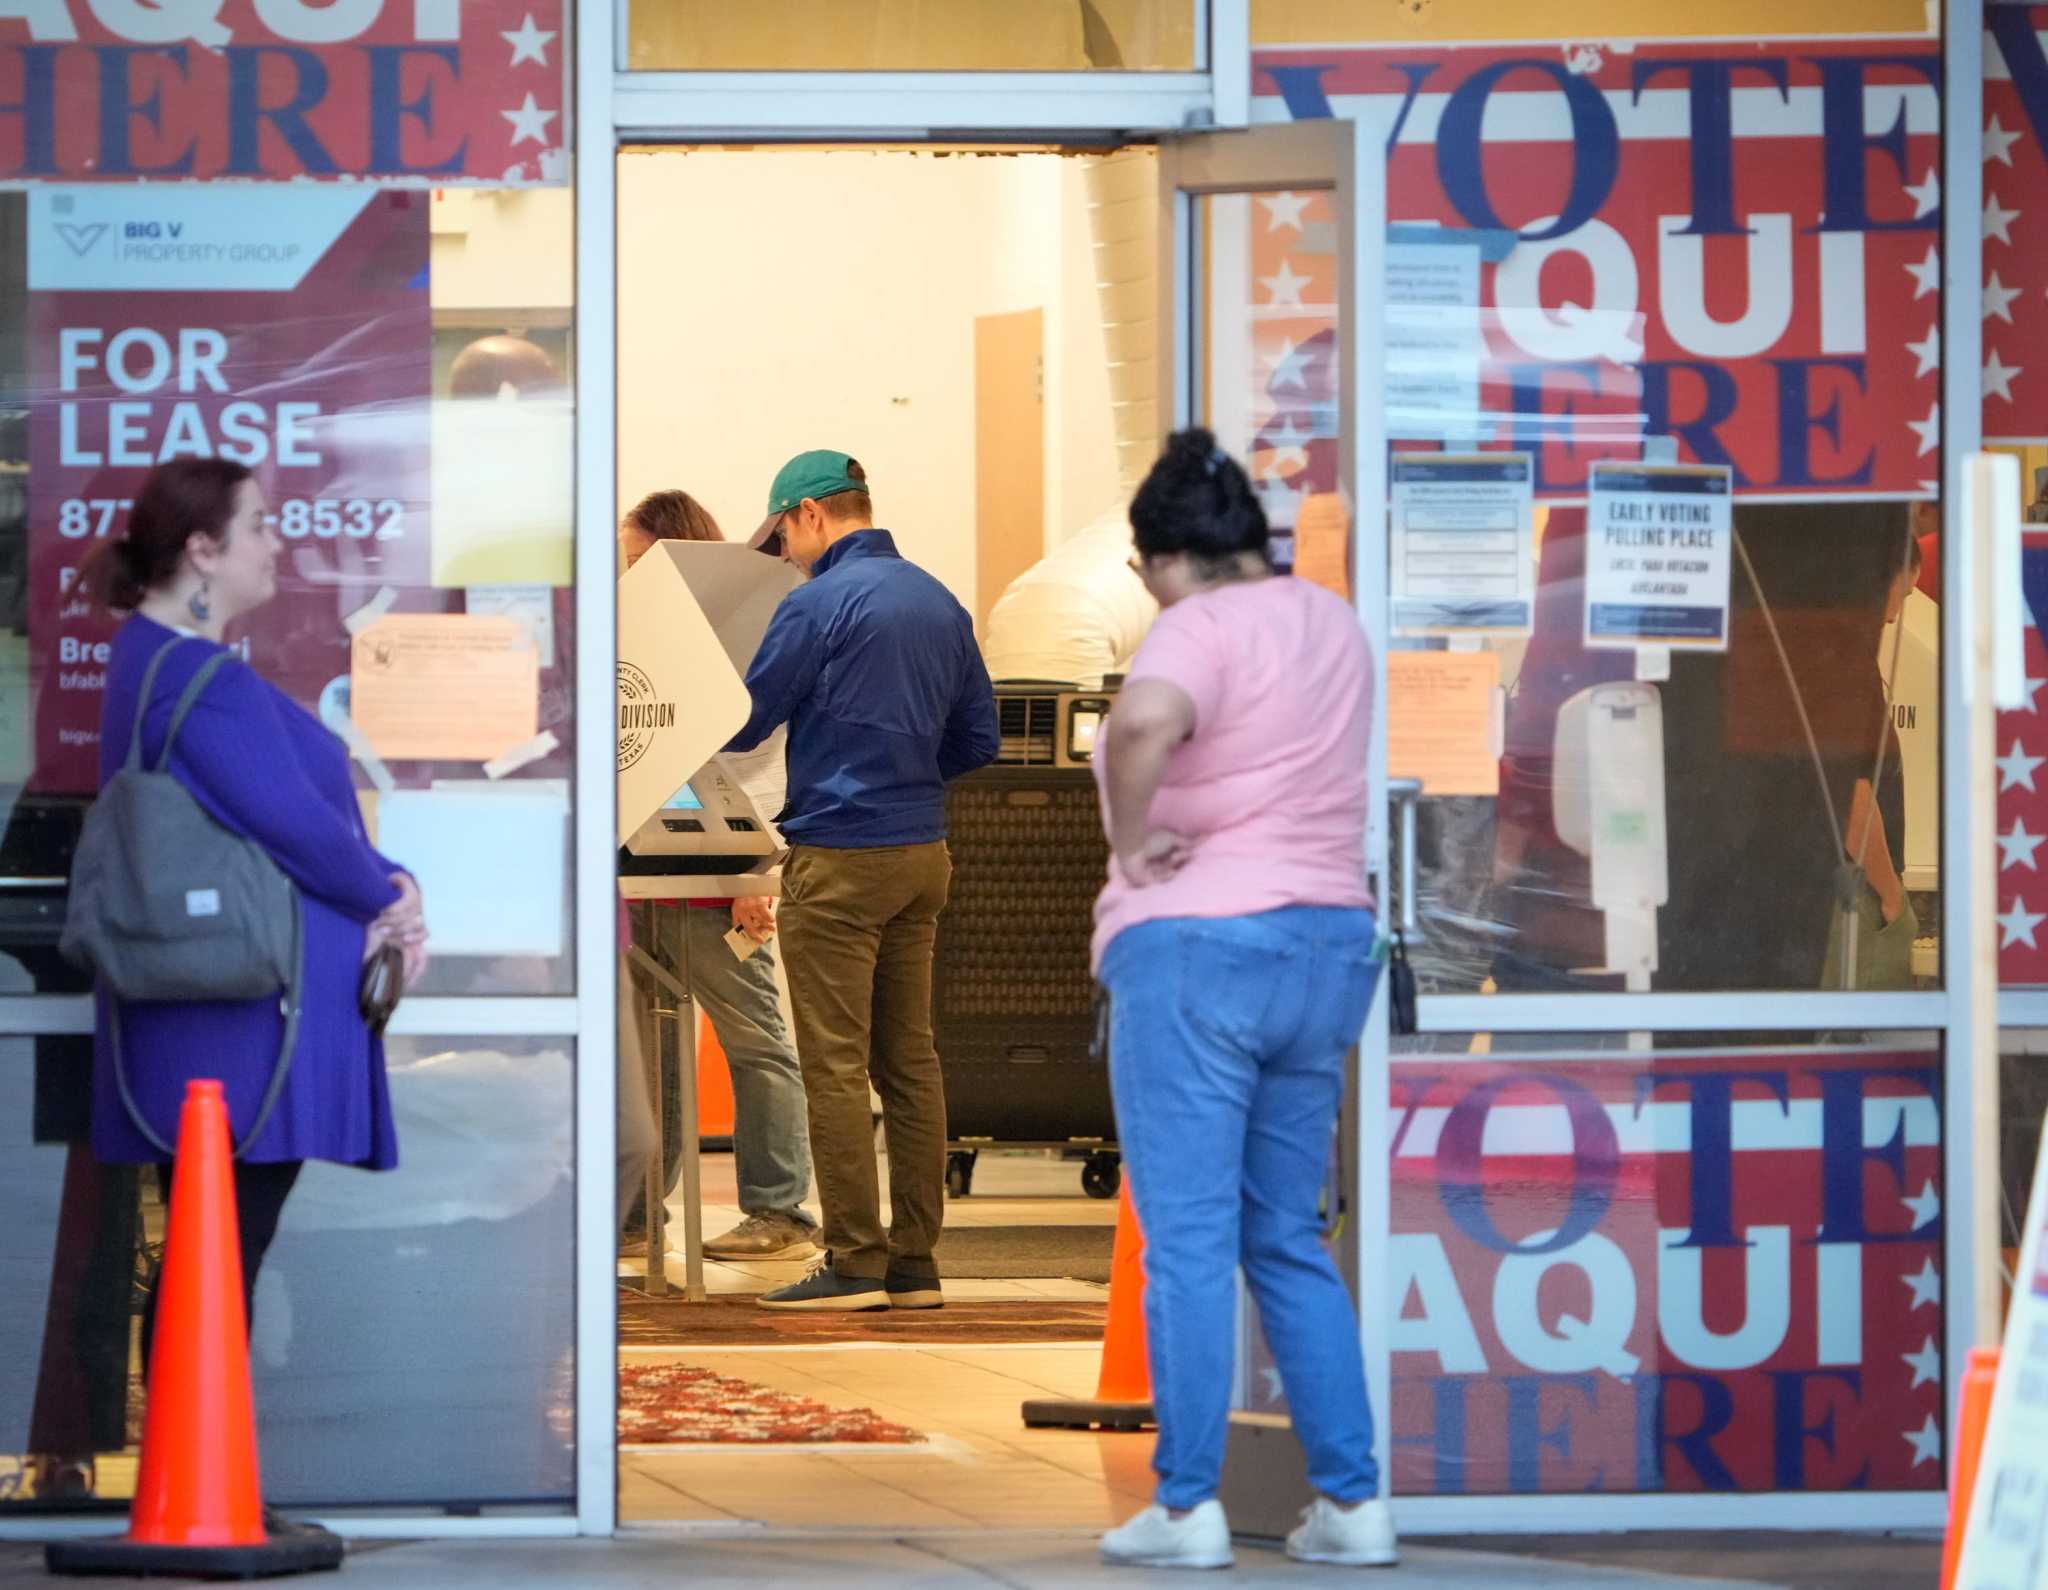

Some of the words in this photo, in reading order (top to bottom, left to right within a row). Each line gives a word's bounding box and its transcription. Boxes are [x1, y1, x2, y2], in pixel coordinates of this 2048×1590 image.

[122, 243, 226, 262] PROPERTY
[228, 243, 300, 262] GROUP
[123, 221, 162, 239] BIG
[167, 221, 183, 239] V
[1392, 213, 1867, 371] QUI
[58, 327, 229, 394] FOR
[59, 400, 323, 468] LEASE
[1505, 358, 1878, 491] ERE
[1605, 526, 1666, 547] POLLING
[1670, 528, 1714, 549] PLACE
[1608, 501, 1656, 523] EARLY
[1659, 502, 1712, 524] VOTING
[621, 703, 675, 729] DIVISION
[618, 742, 644, 766] TEXAS
[1390, 1066, 1939, 1256] OTE
[1390, 1224, 1863, 1384] AQUI
[1390, 1369, 1872, 1491] HERE
